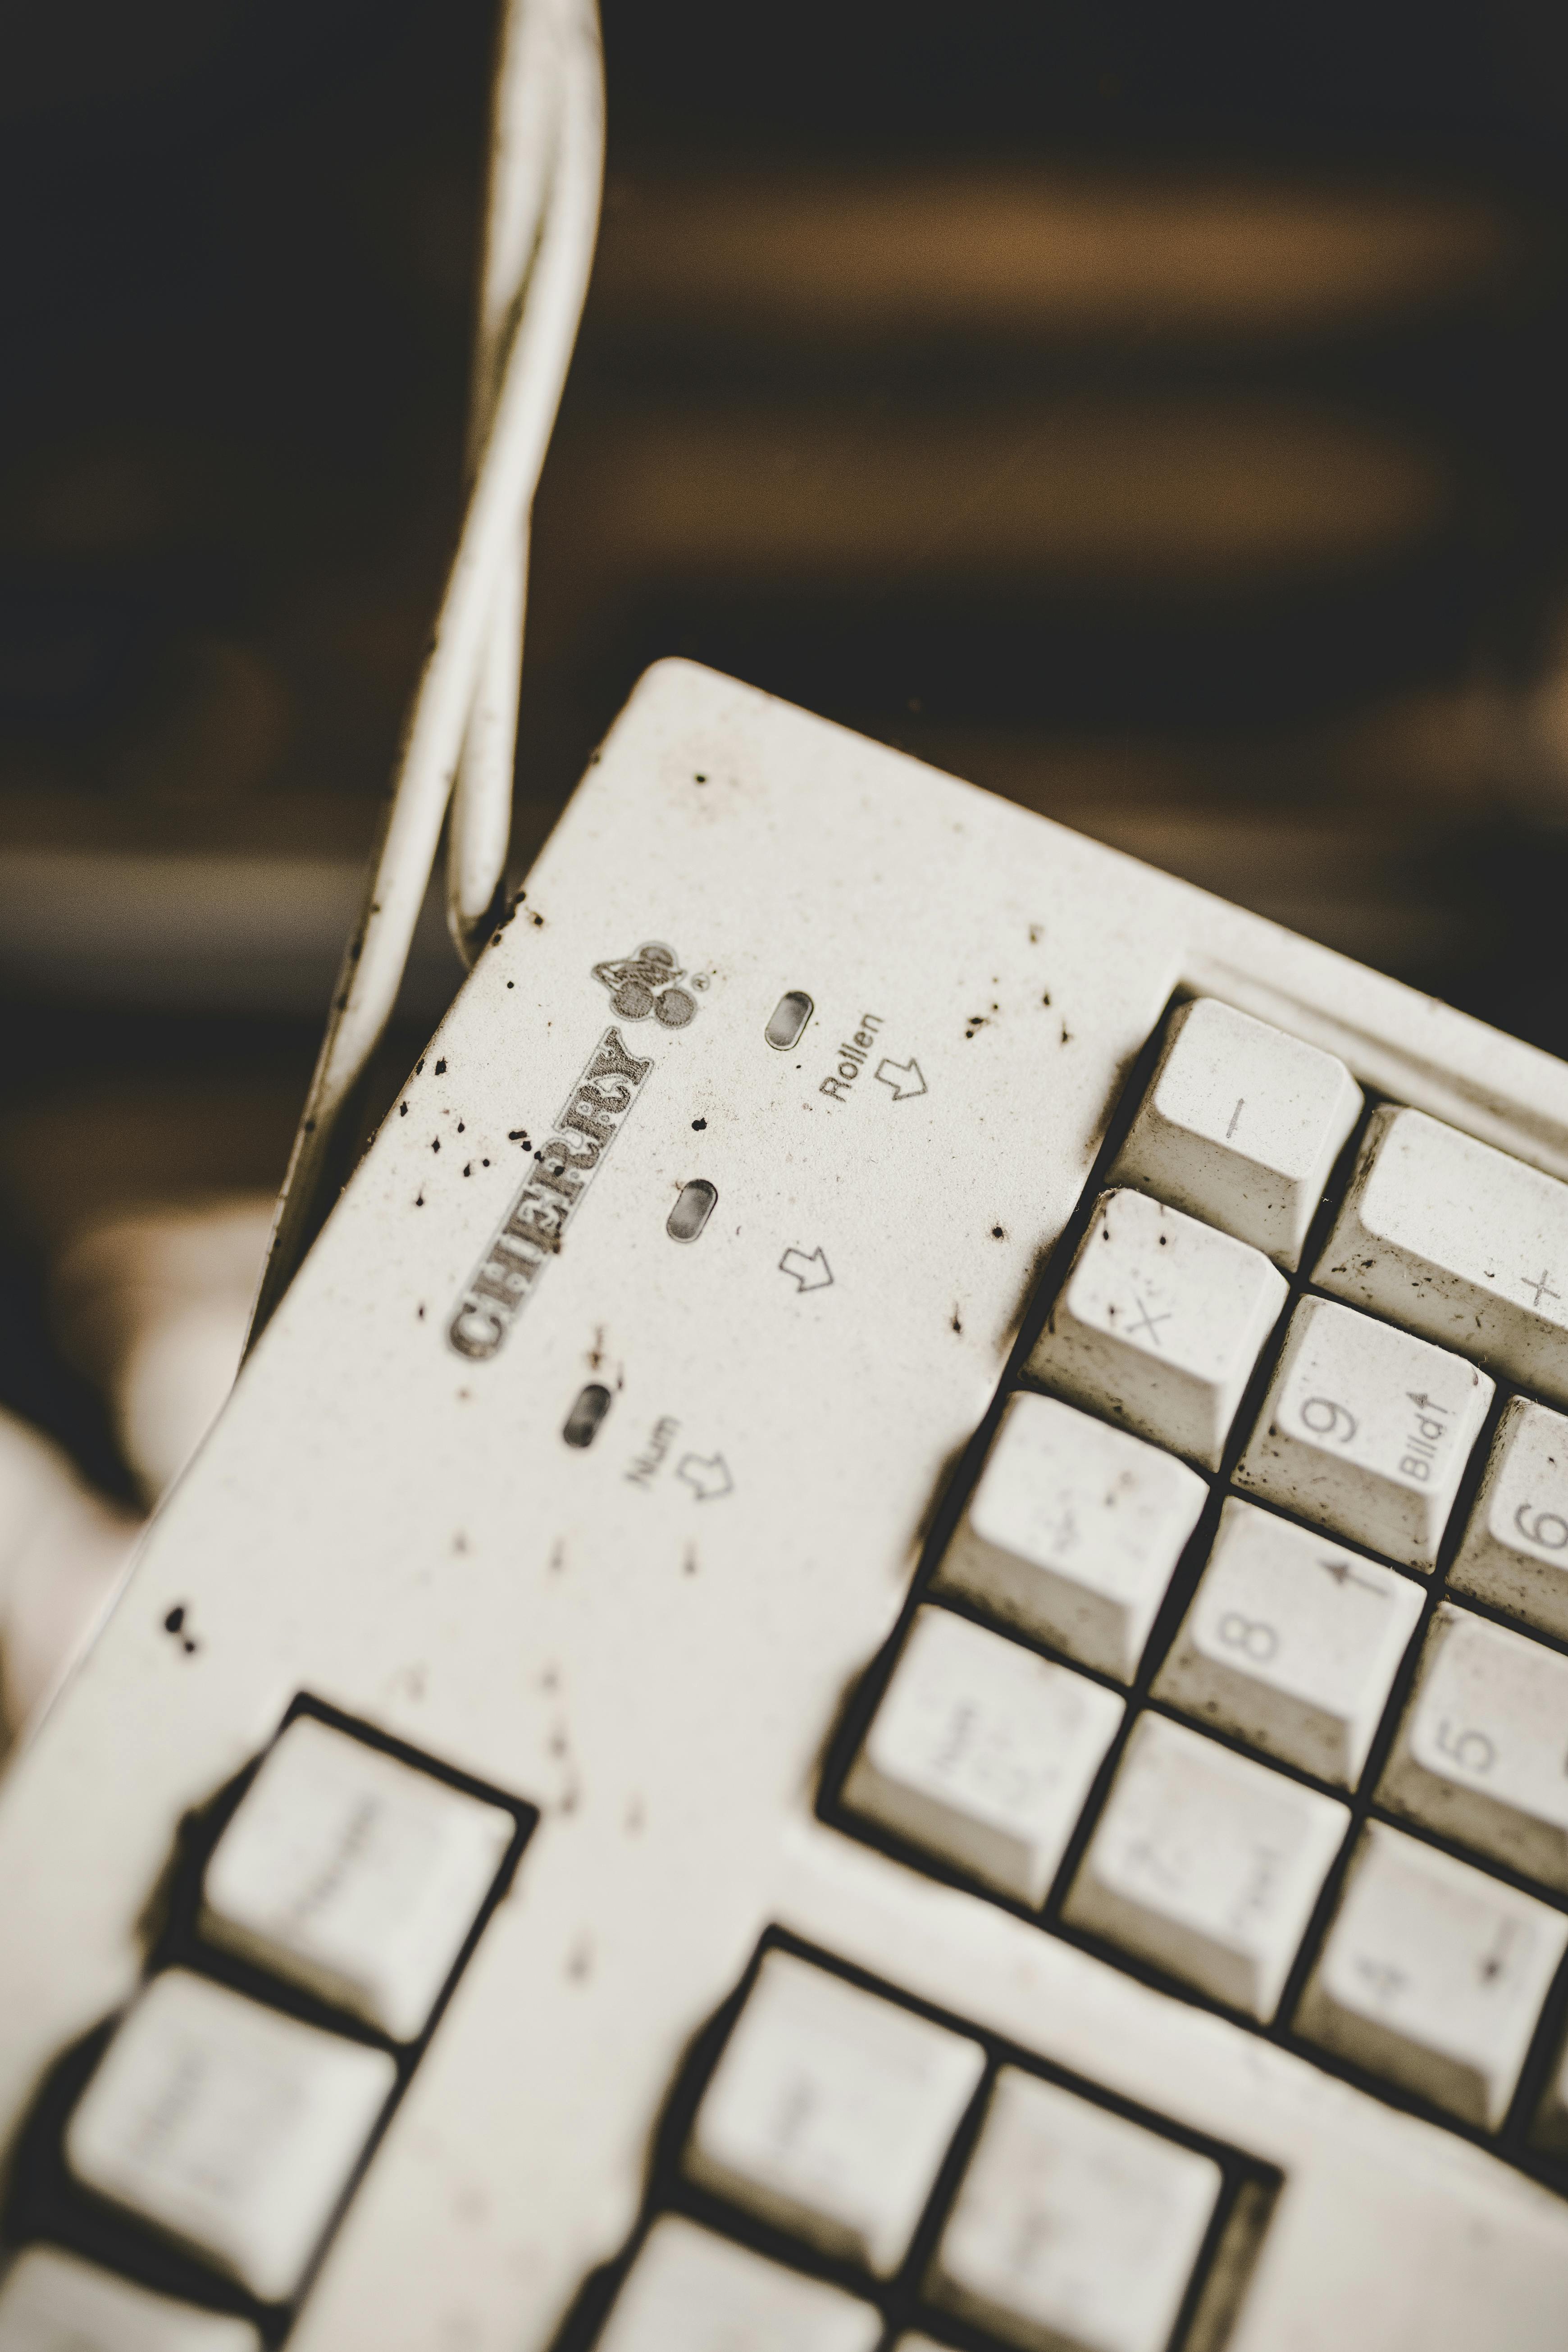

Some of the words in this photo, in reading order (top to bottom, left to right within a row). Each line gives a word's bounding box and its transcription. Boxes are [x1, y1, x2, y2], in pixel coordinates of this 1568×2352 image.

[819, 1012, 884, 1102] Rollen
[447, 1026, 653, 1359] CHERRY
[1299, 1395, 1360, 1444] 9
[623, 1416, 679, 1491] Num
[1514, 1504, 1568, 1550] 6
[1217, 1612, 1278, 1662] 8
[1436, 1719, 1496, 1773] 5
